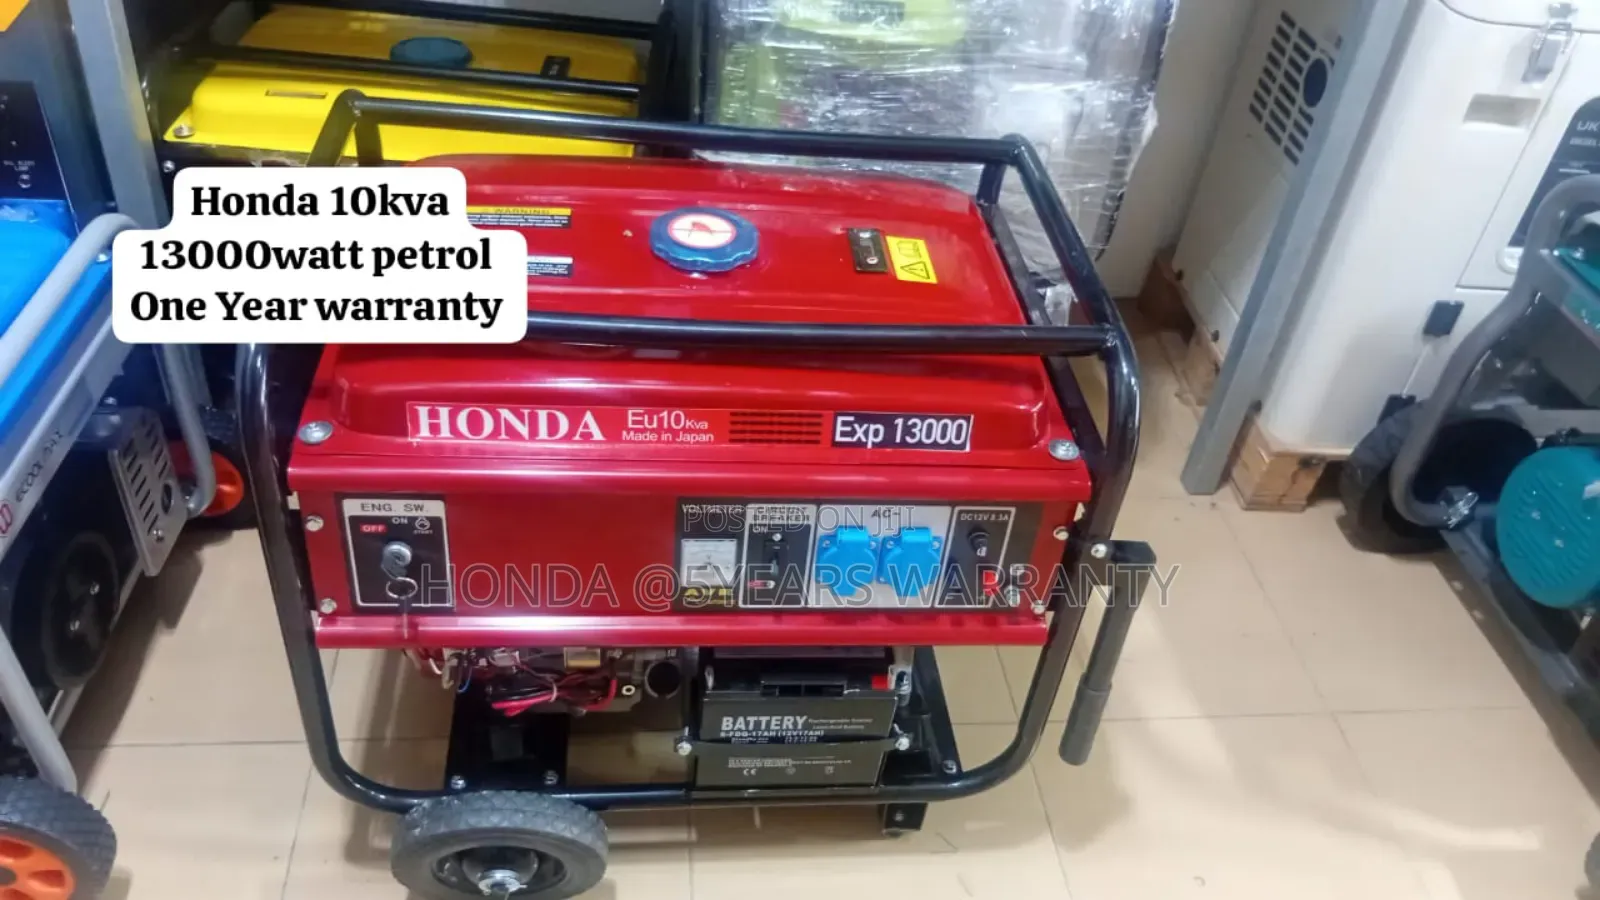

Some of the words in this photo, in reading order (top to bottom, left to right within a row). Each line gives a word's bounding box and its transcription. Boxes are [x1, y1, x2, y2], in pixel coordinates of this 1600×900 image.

[413, 404, 606, 442] HONDA
[622, 430, 658, 441] Made
[661, 430, 673, 441] in
[675, 431, 714, 444] Japan
[835, 415, 885, 449] Exp
[893, 417, 968, 446] 13000
[391, 516, 409, 525] ON
[362, 524, 387, 533] OFF
[720, 715, 808, 731] BATTERY
